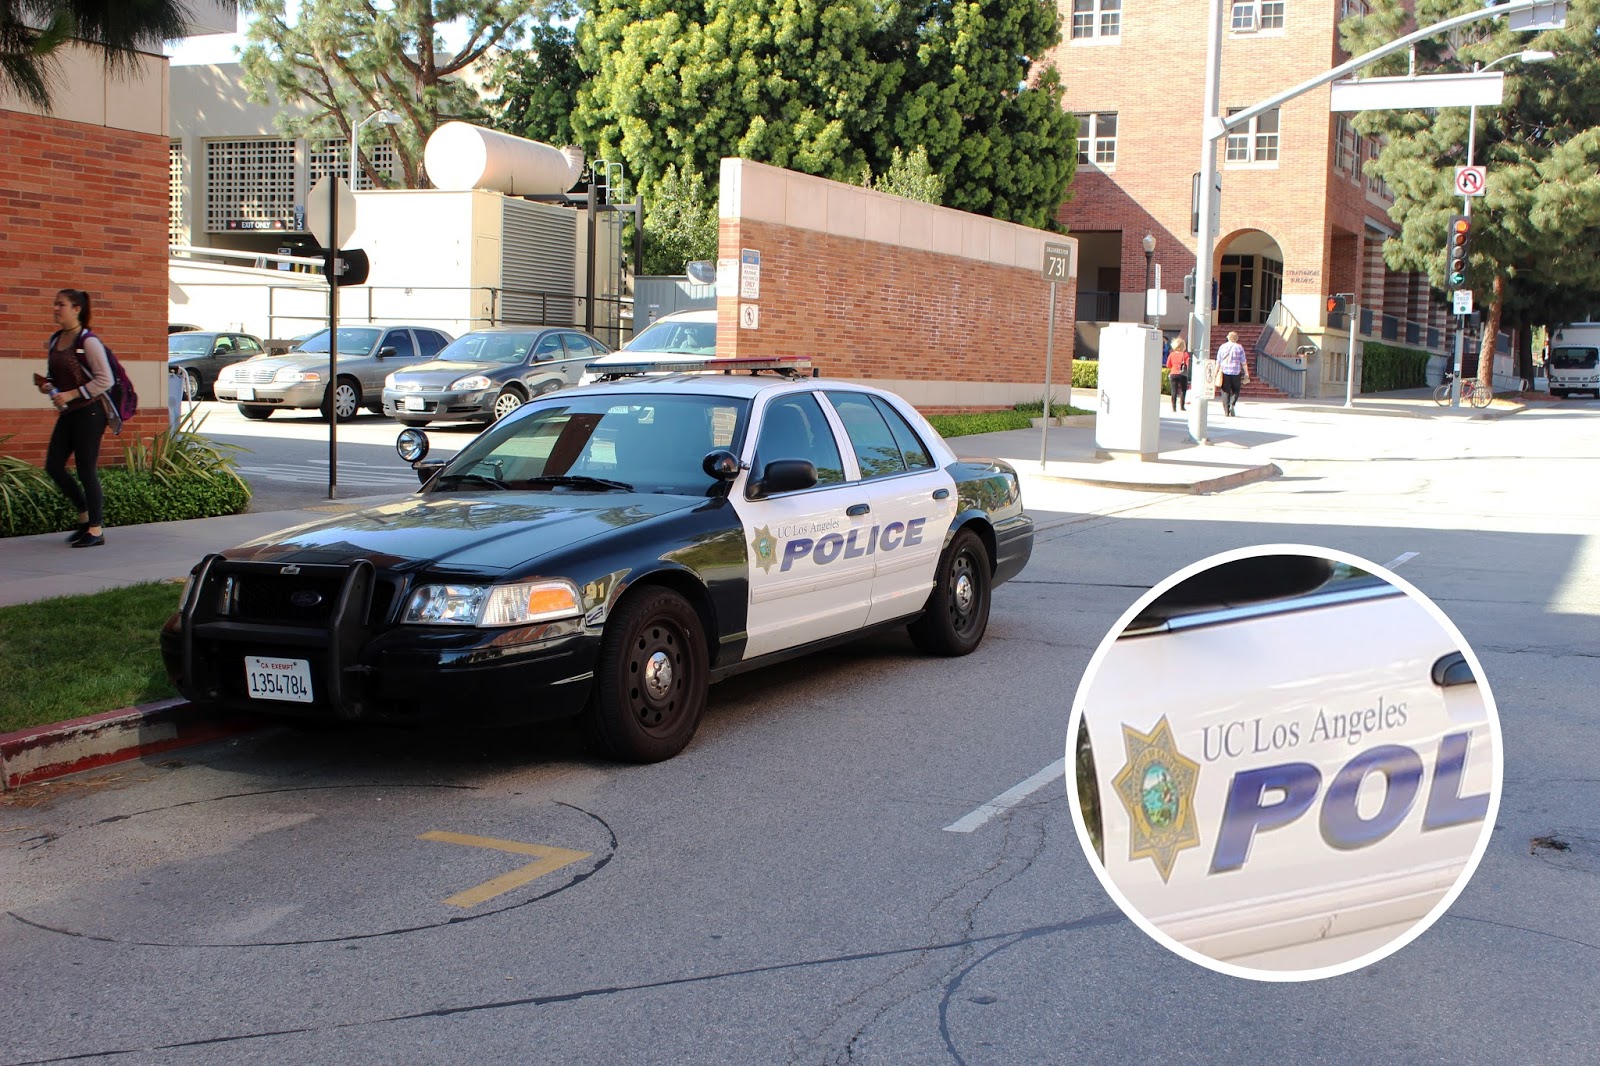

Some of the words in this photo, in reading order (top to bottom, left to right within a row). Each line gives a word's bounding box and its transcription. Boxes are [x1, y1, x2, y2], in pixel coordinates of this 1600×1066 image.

[241, 221, 254, 229] EXIT
[255, 221, 271, 229] ONLY
[297, 218, 303, 228] 5
[1048, 256, 1066, 277] 731
[777, 526, 791, 538] UC
[793, 525, 808, 536] Los
[810, 519, 840, 534] Angeles
[779, 517, 927, 572] POLICE
[586, 582, 605, 599] 91
[251, 672, 308, 695] 1354784
[1202, 720, 1245, 762] UC
[1253, 716, 1300, 754] Los
[1309, 696, 1408, 746] Angeles
